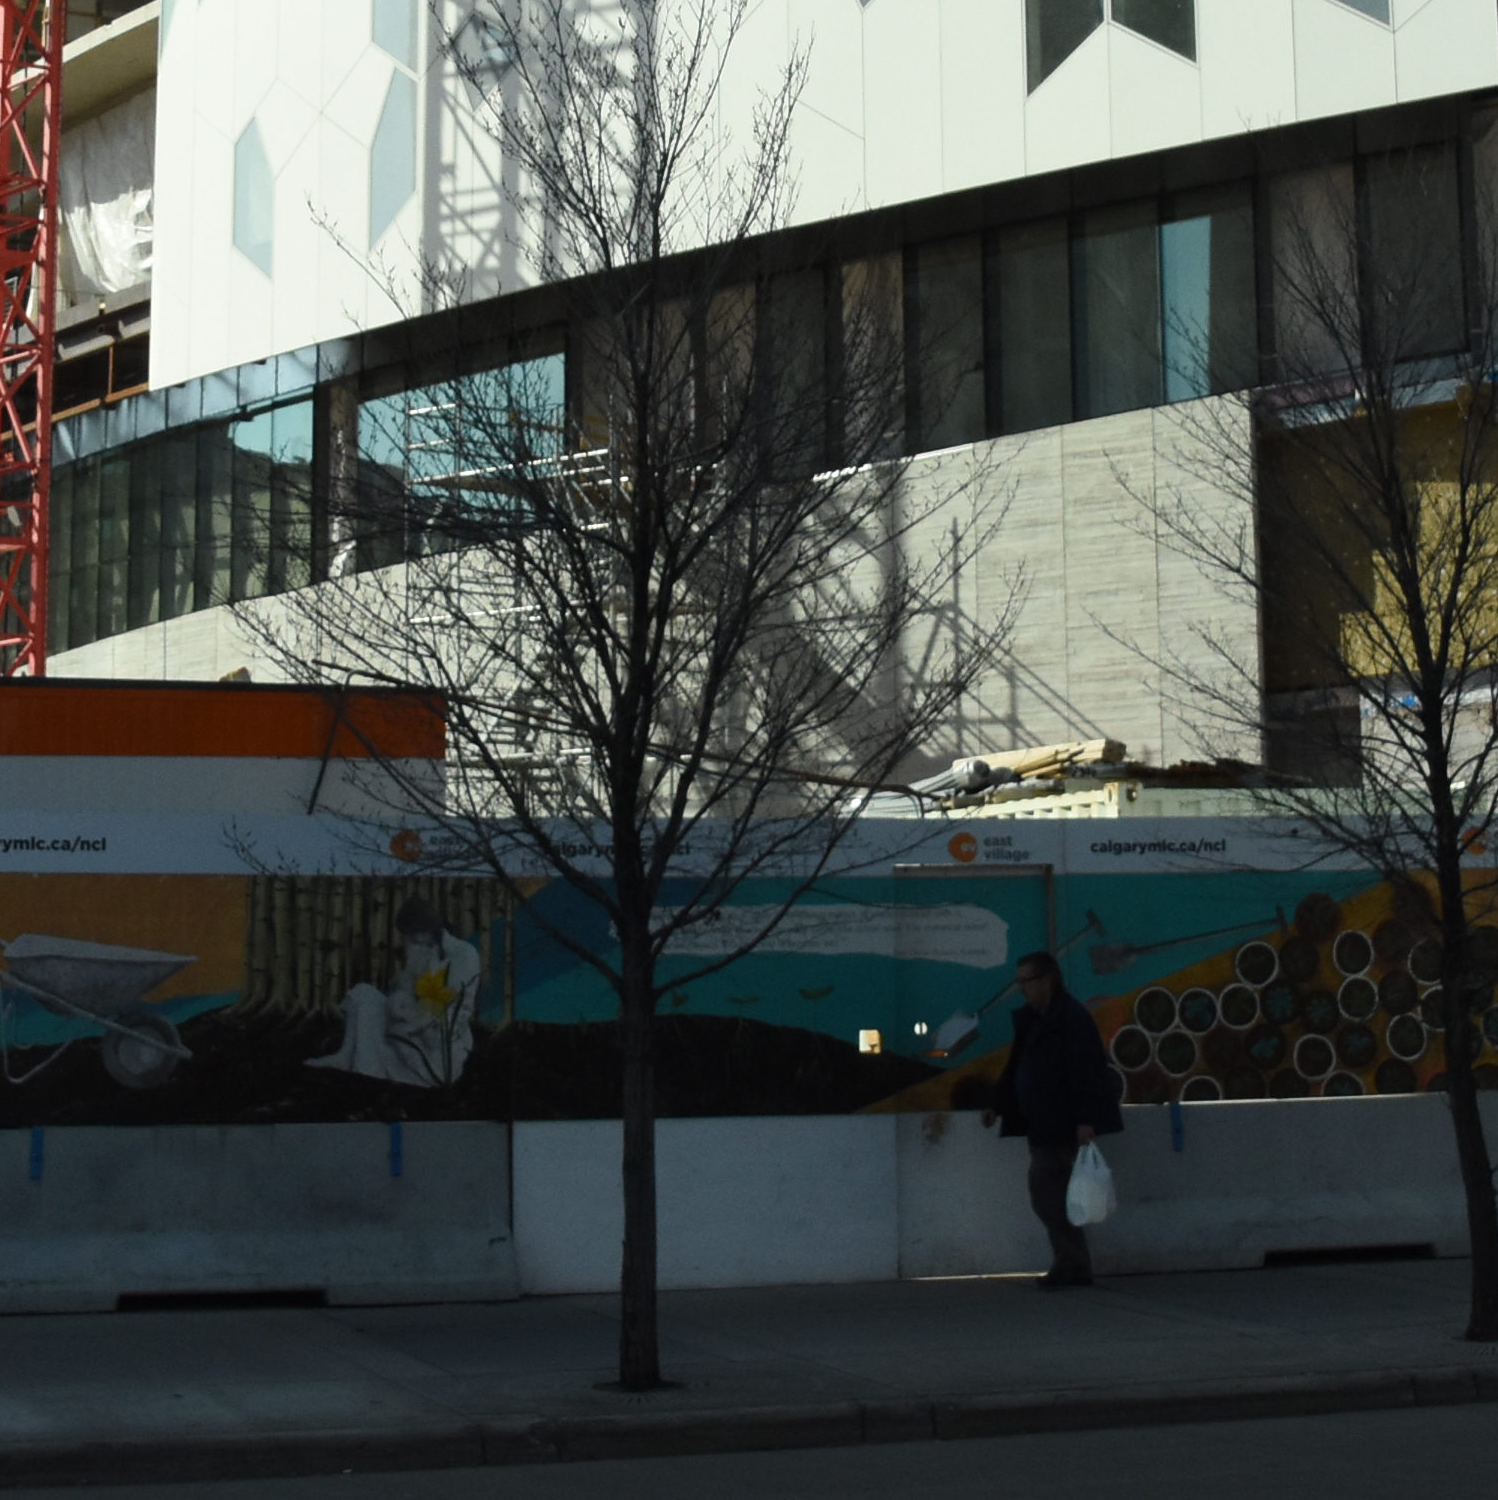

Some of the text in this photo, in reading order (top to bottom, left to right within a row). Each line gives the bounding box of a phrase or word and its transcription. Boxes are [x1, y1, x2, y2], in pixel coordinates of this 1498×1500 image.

[983, 835, 1012, 847] east
[1090, 838, 1226, 854] calgarymlc.ca/ncl
[984, 848, 1029, 861] village
